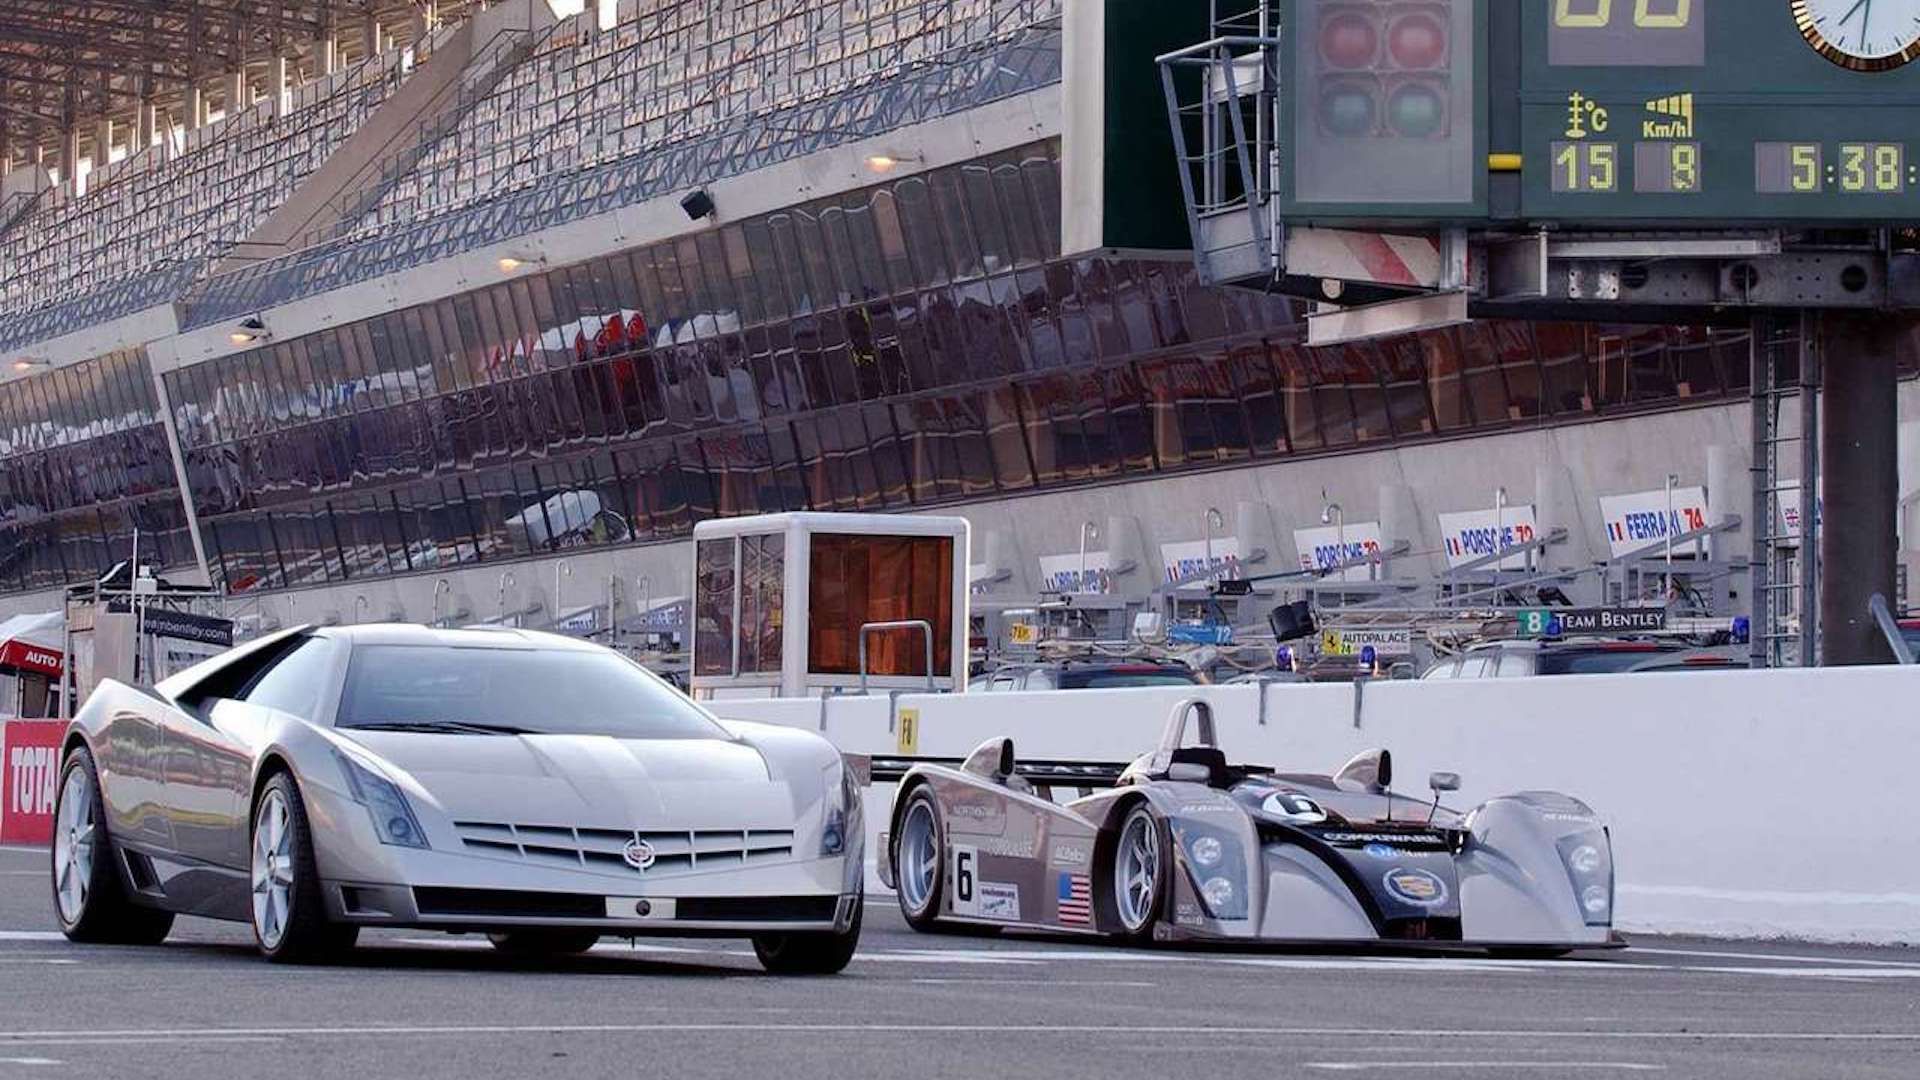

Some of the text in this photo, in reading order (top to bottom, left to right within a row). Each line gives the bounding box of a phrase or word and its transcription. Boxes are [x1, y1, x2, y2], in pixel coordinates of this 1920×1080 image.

[1643, 121, 1686, 138] Km/h
[1556, 145, 1613, 189] 15
[144, 619, 228, 640] eambentley.com
[1527, 611, 1542, 632] 8
[1600, 611, 1663, 628] BENTLEY
[25, 650, 58, 668] AUTO
[957, 851, 973, 902] 6
